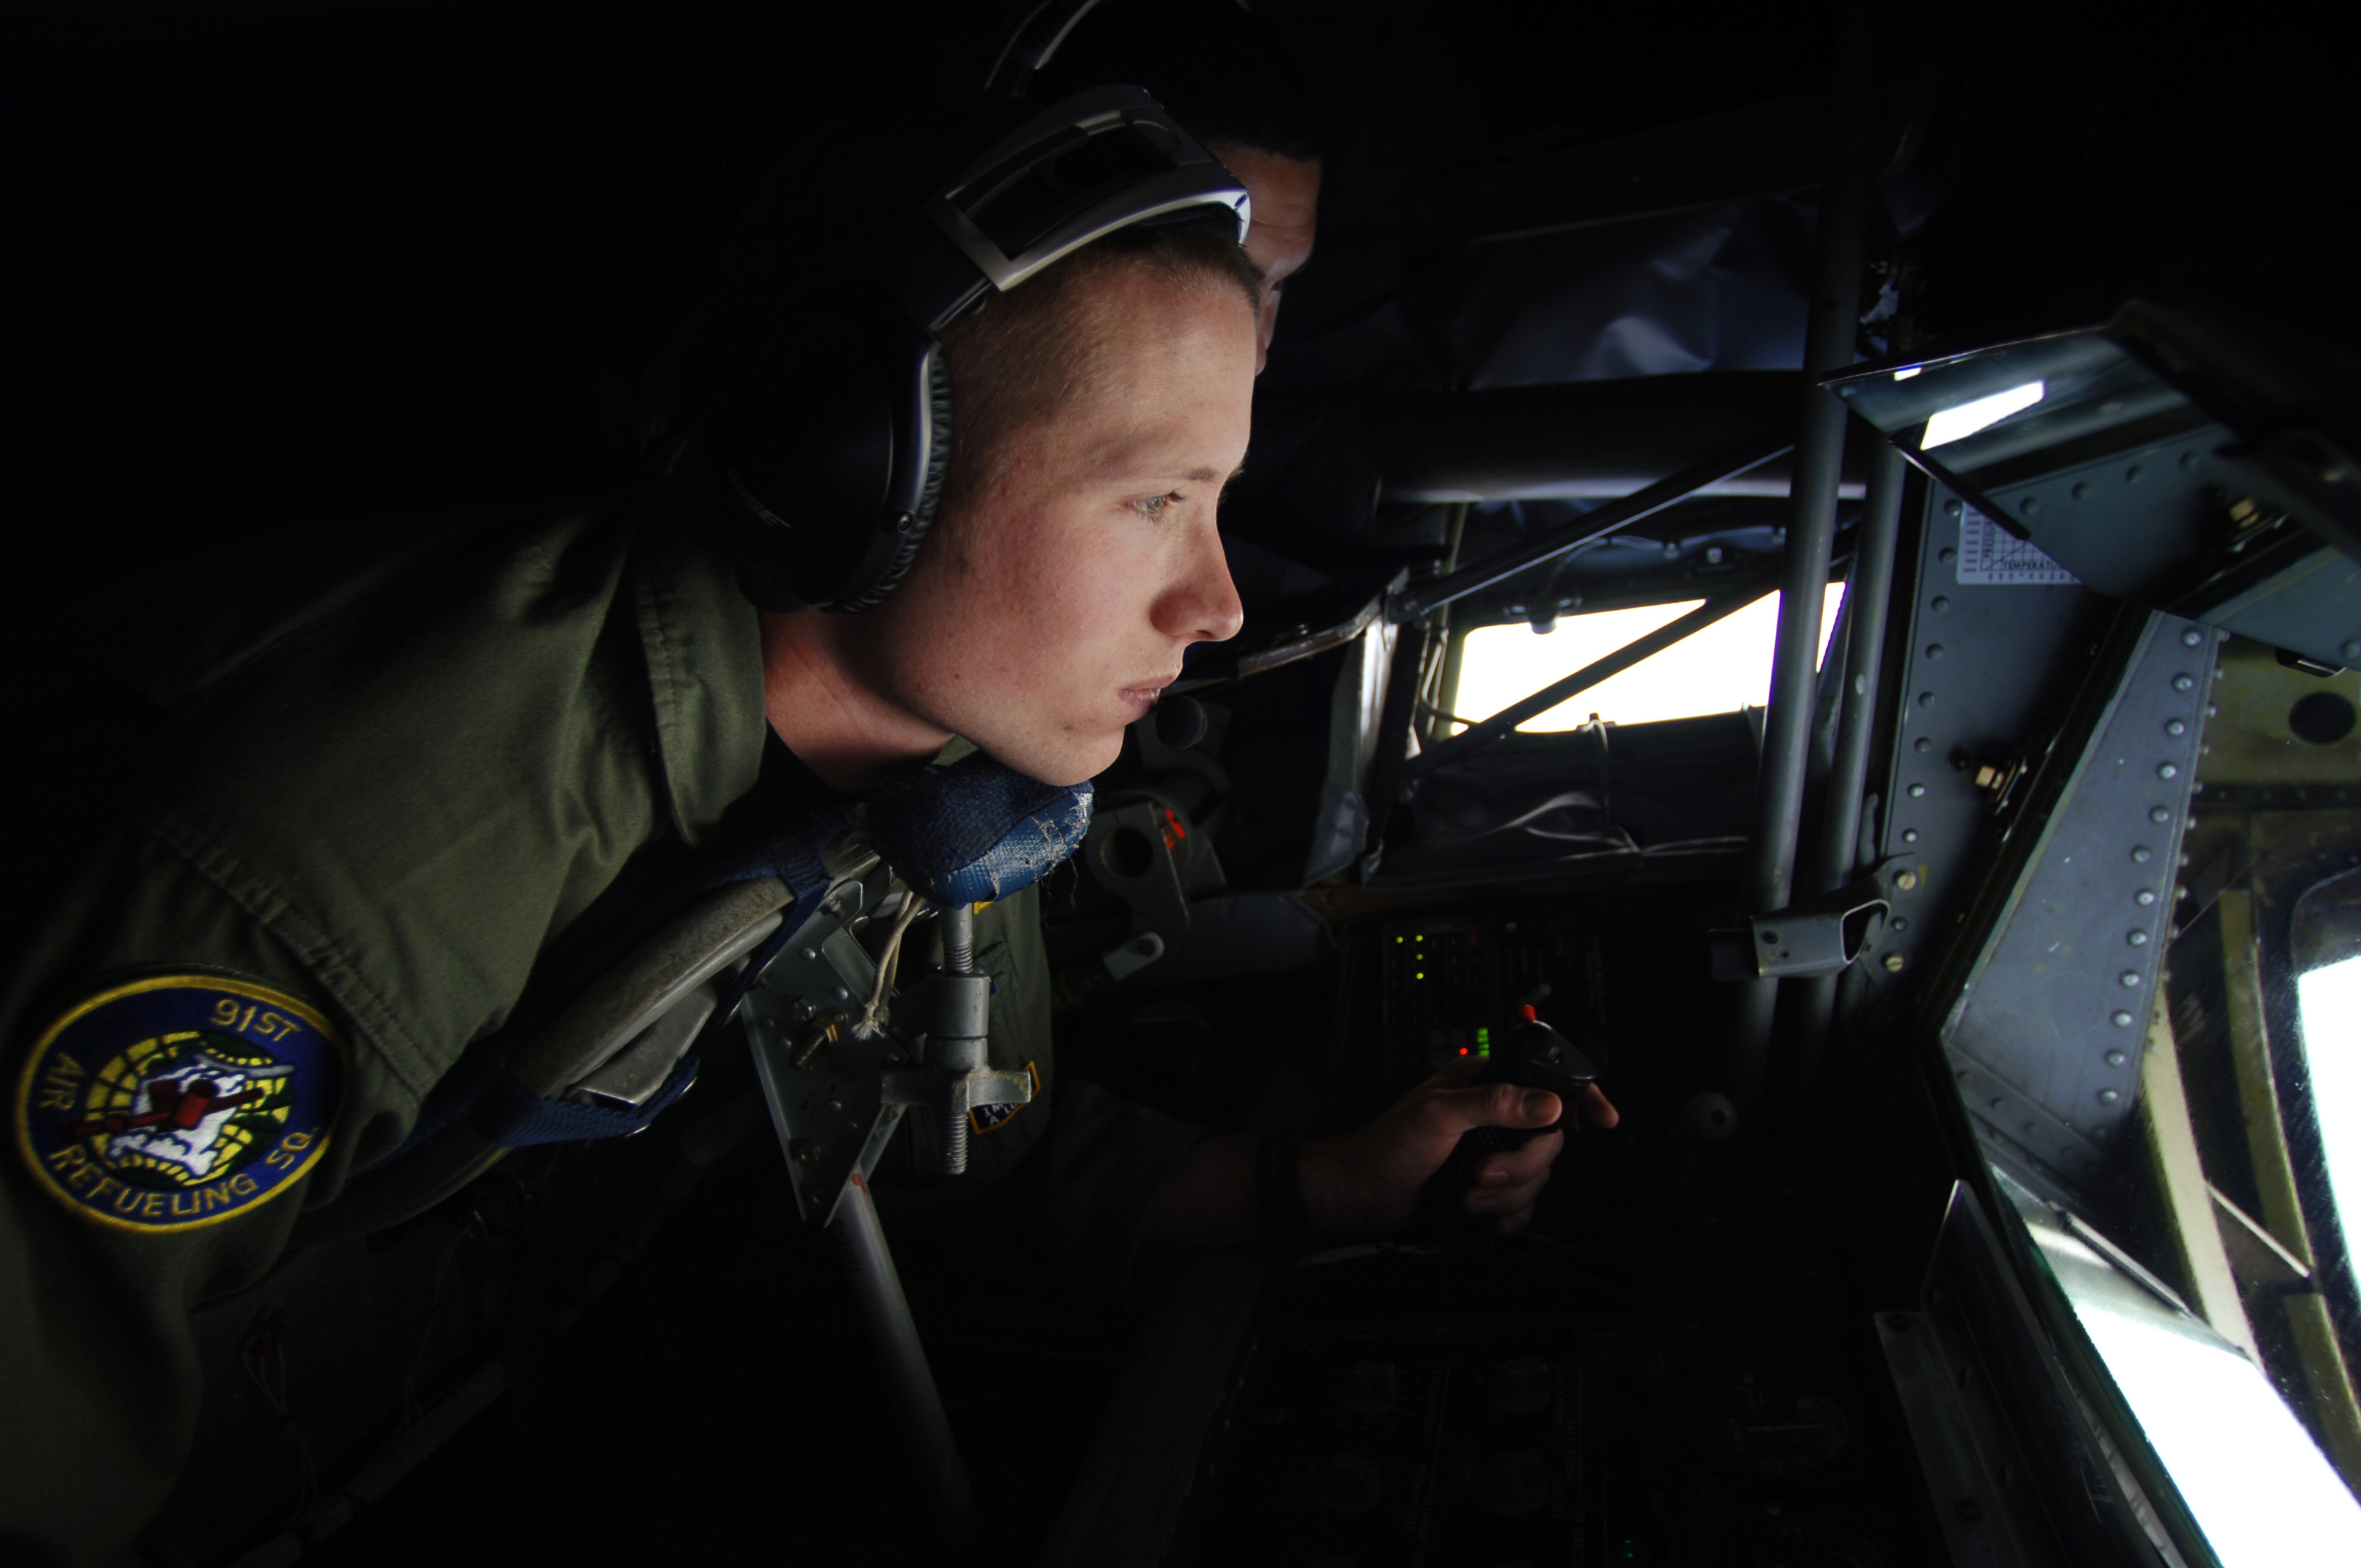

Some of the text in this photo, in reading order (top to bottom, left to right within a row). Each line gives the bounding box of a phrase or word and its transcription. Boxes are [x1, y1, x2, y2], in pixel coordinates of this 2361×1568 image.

[2004, 559, 2061, 570] TEMPERATU
[210, 999, 302, 1042] 91ST
[38, 1052, 87, 1111] AIR
[48, 1144, 259, 1217] REFUELING
